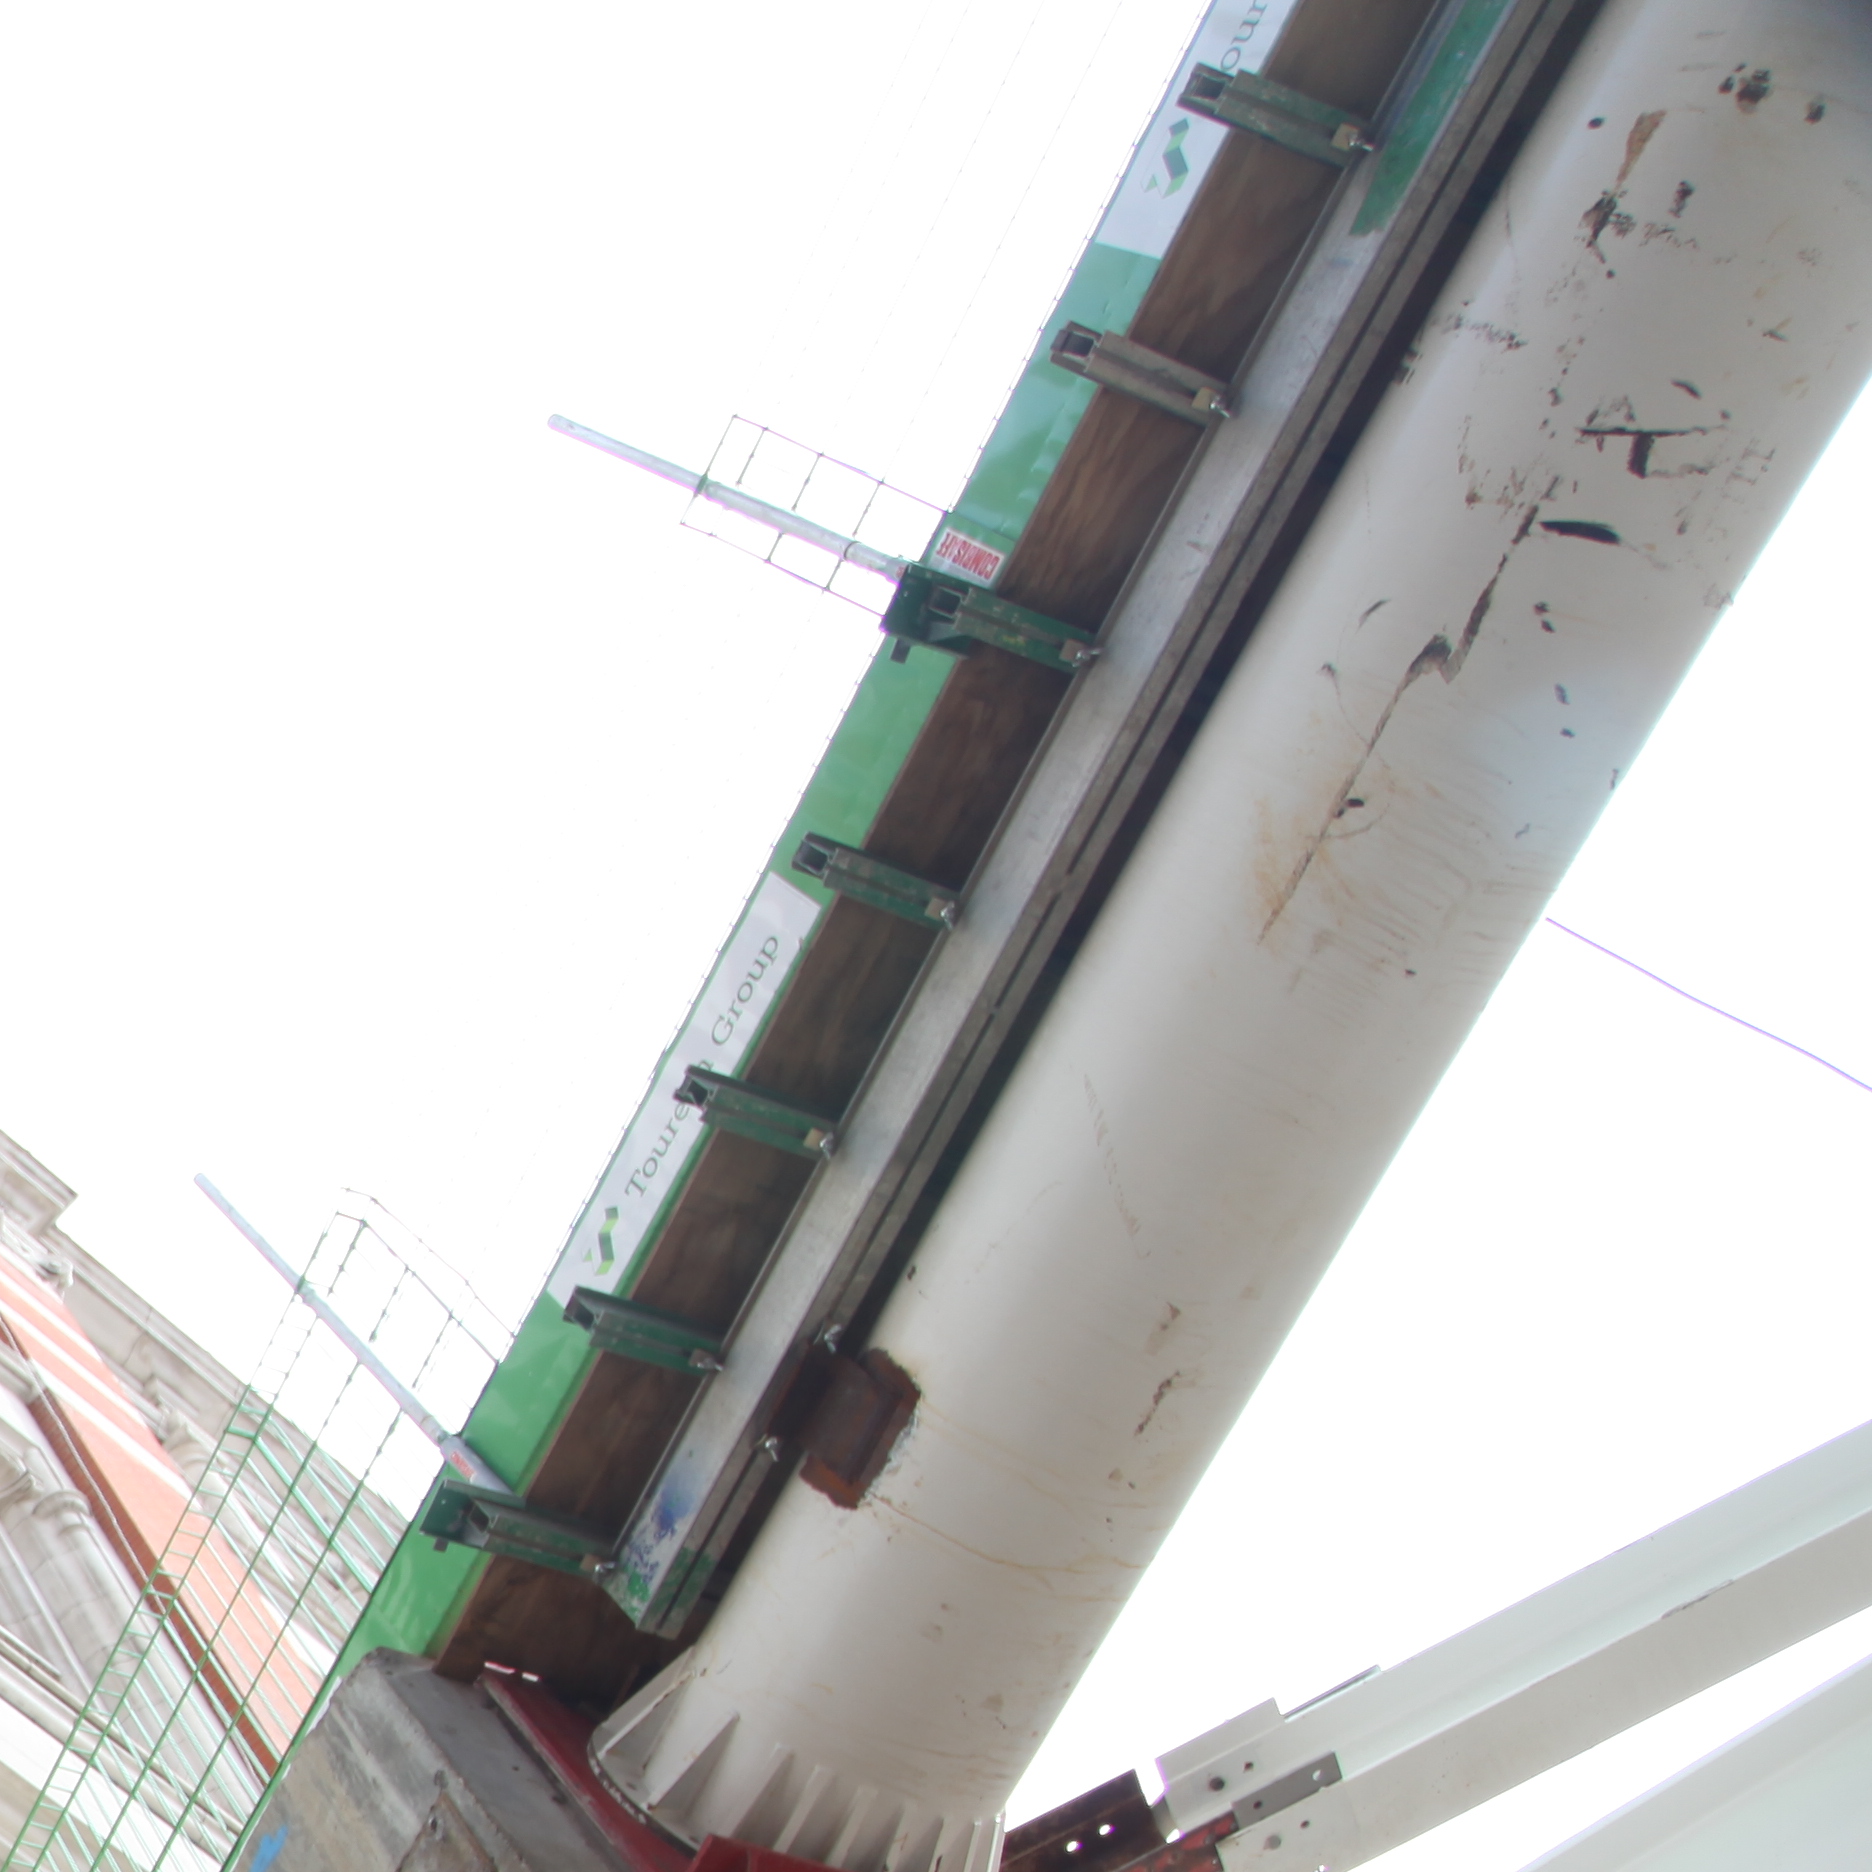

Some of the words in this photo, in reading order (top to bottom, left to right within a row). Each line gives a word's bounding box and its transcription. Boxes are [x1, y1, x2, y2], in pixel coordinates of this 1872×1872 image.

[1220, 0, 1267, 71] our
[624, 1059, 714, 1198] Touren
[711, 936, 779, 1046] Group
